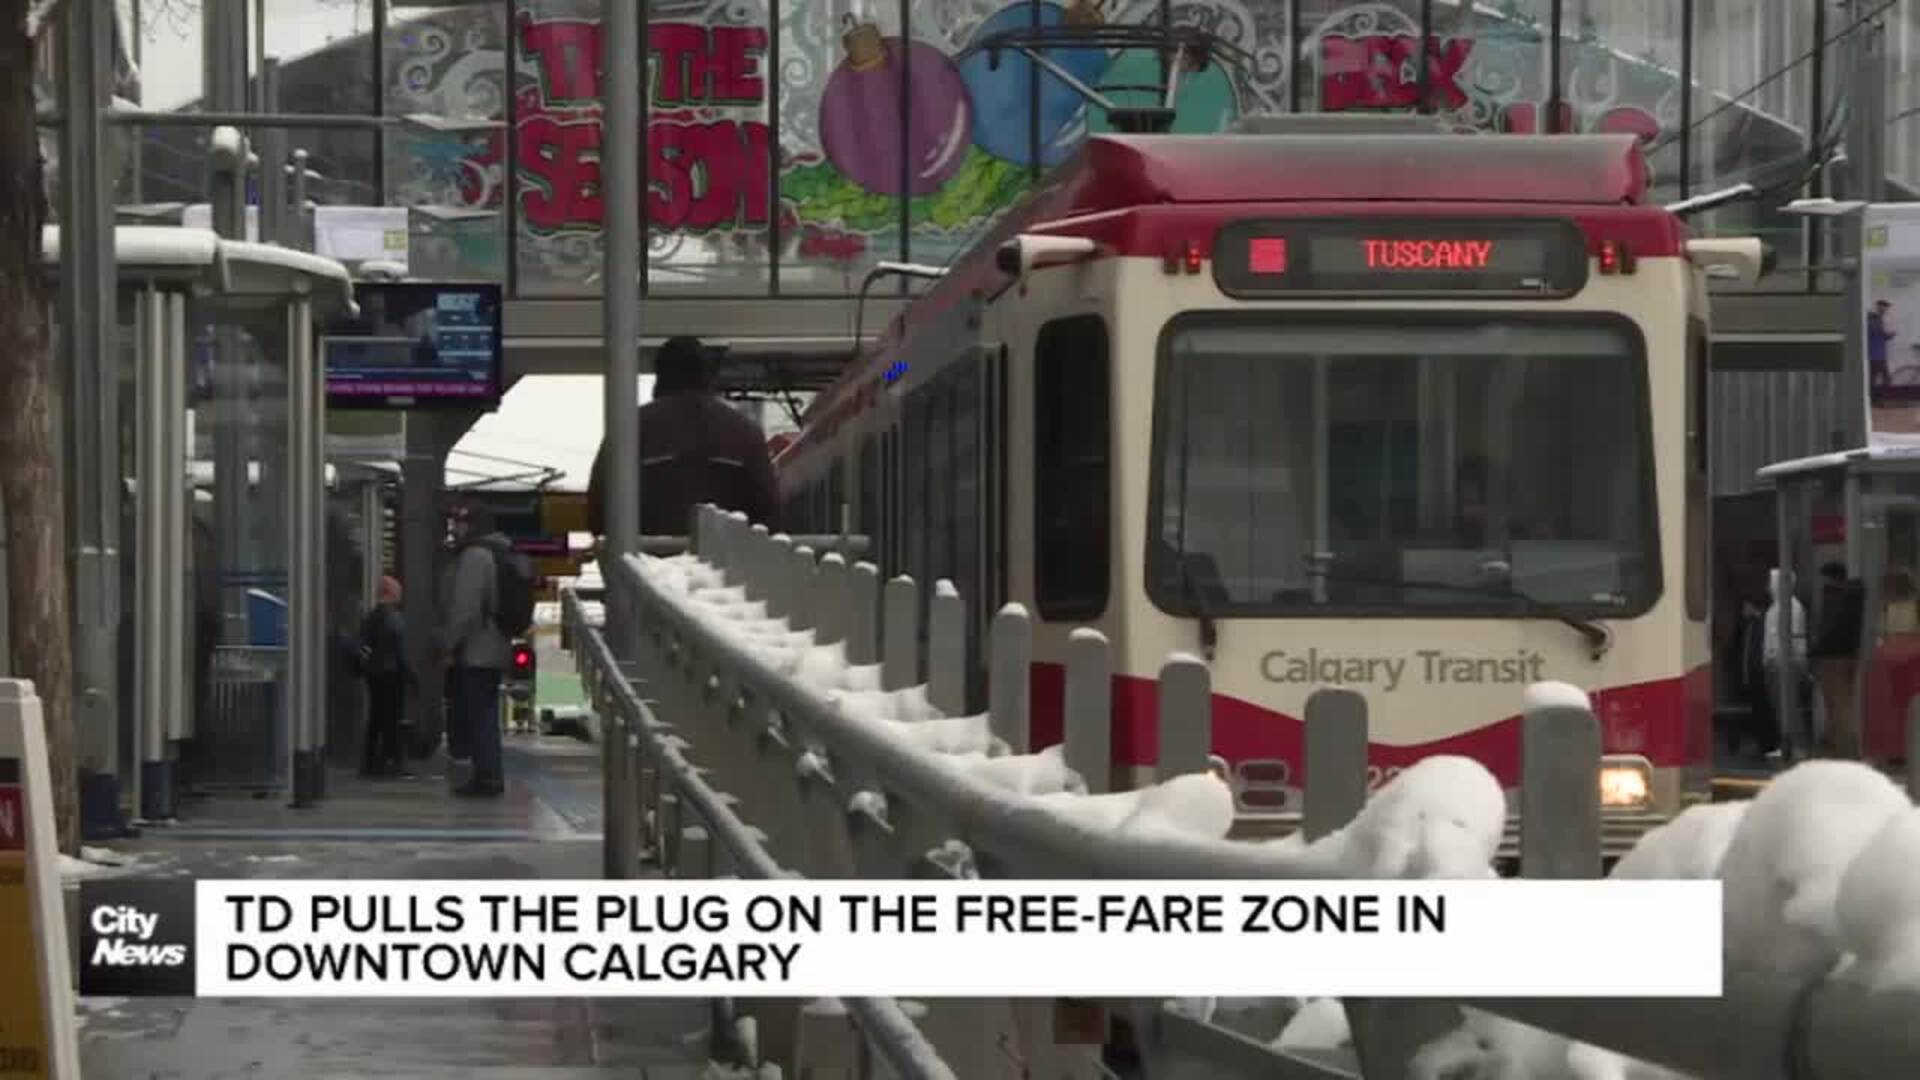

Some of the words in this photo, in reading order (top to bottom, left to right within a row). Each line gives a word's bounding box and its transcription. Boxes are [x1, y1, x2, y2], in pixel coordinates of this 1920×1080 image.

[643, 23, 768, 106] THE
[516, 118, 769, 232] SESON
[1366, 240, 1493, 268] TUSCANY
[1260, 648, 1405, 692] Calgary
[1416, 648, 1546, 684] Transit
